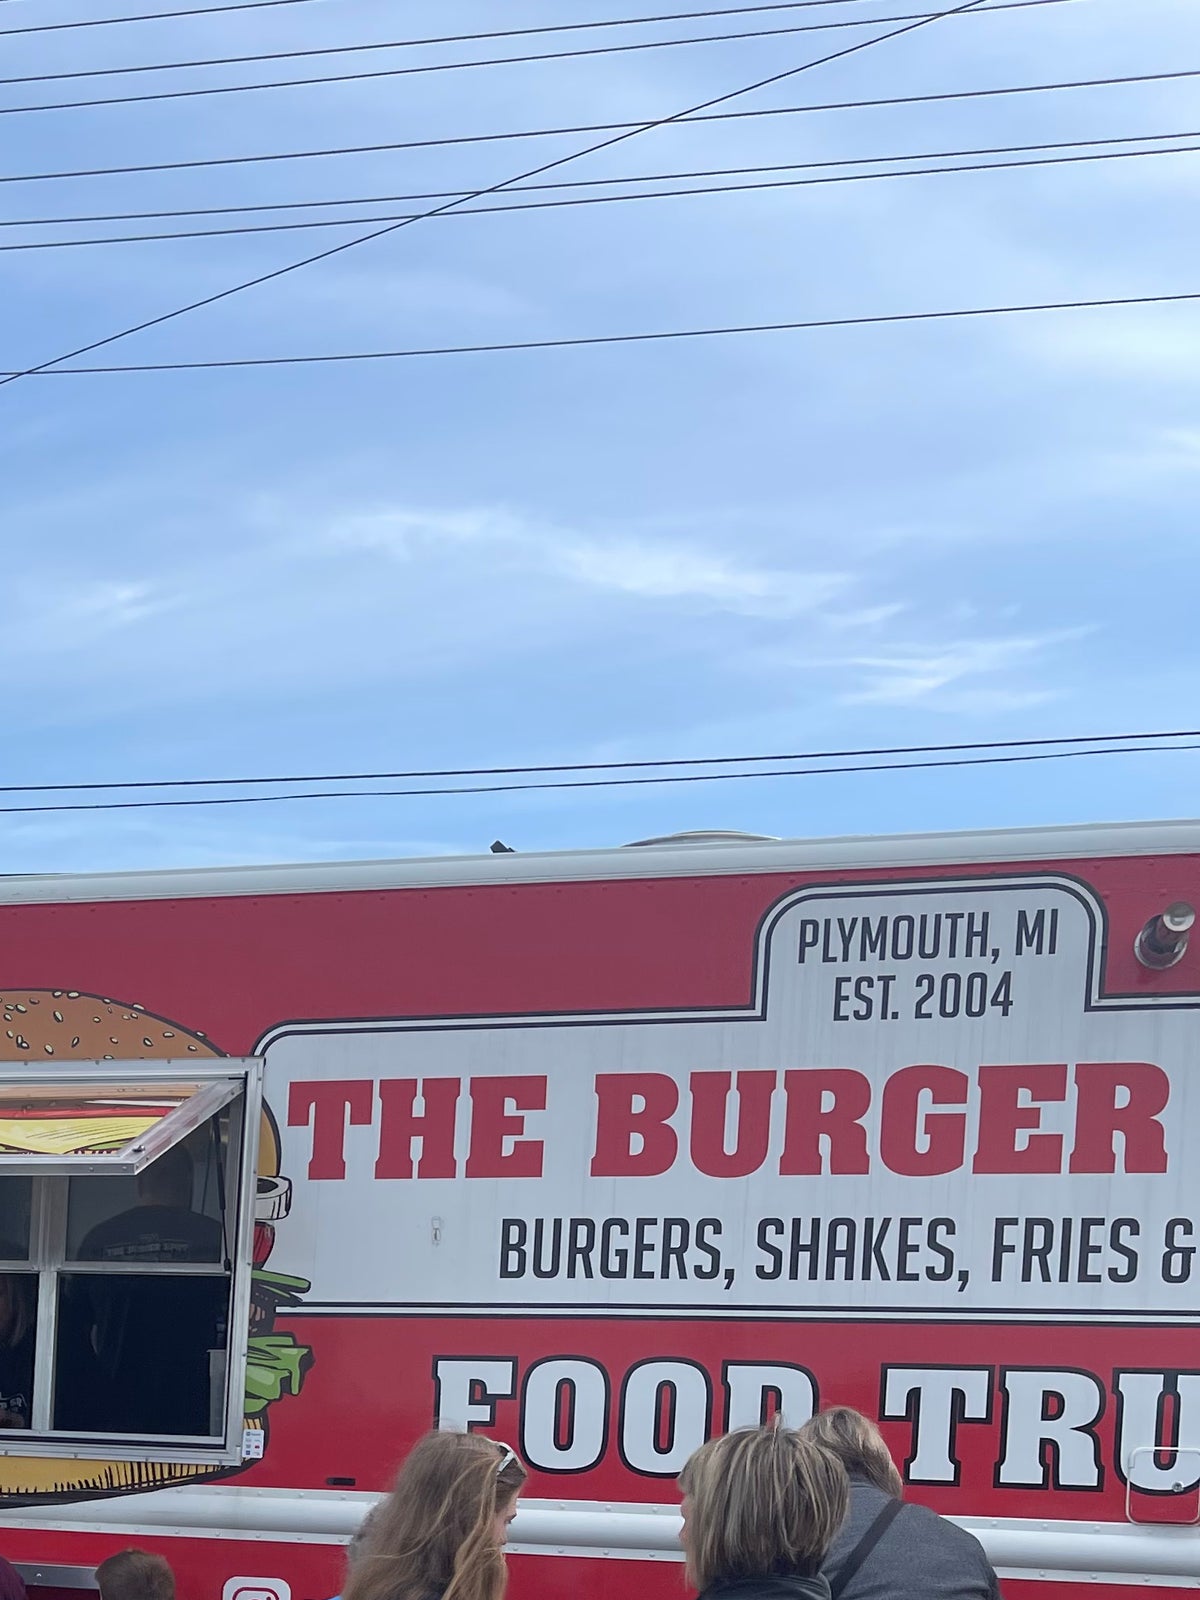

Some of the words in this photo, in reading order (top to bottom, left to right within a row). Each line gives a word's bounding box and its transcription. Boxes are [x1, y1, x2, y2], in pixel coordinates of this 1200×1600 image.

[797, 911, 1000, 964] PLYMOUTH,
[1015, 908, 1059, 956] MI
[833, 974, 899, 1022] EST.
[914, 970, 1014, 1019] 2004
[287, 1075, 548, 1180] THE
[590, 1062, 1170, 1179] BURGER
[499, 1217, 736, 1290] BURGERS,
[755, 1217, 970, 1293] SHAKES,
[991, 1217, 1141, 1284] FRIES
[1161, 1217, 1197, 1284] &
[432, 1355, 820, 1479] FOOD
